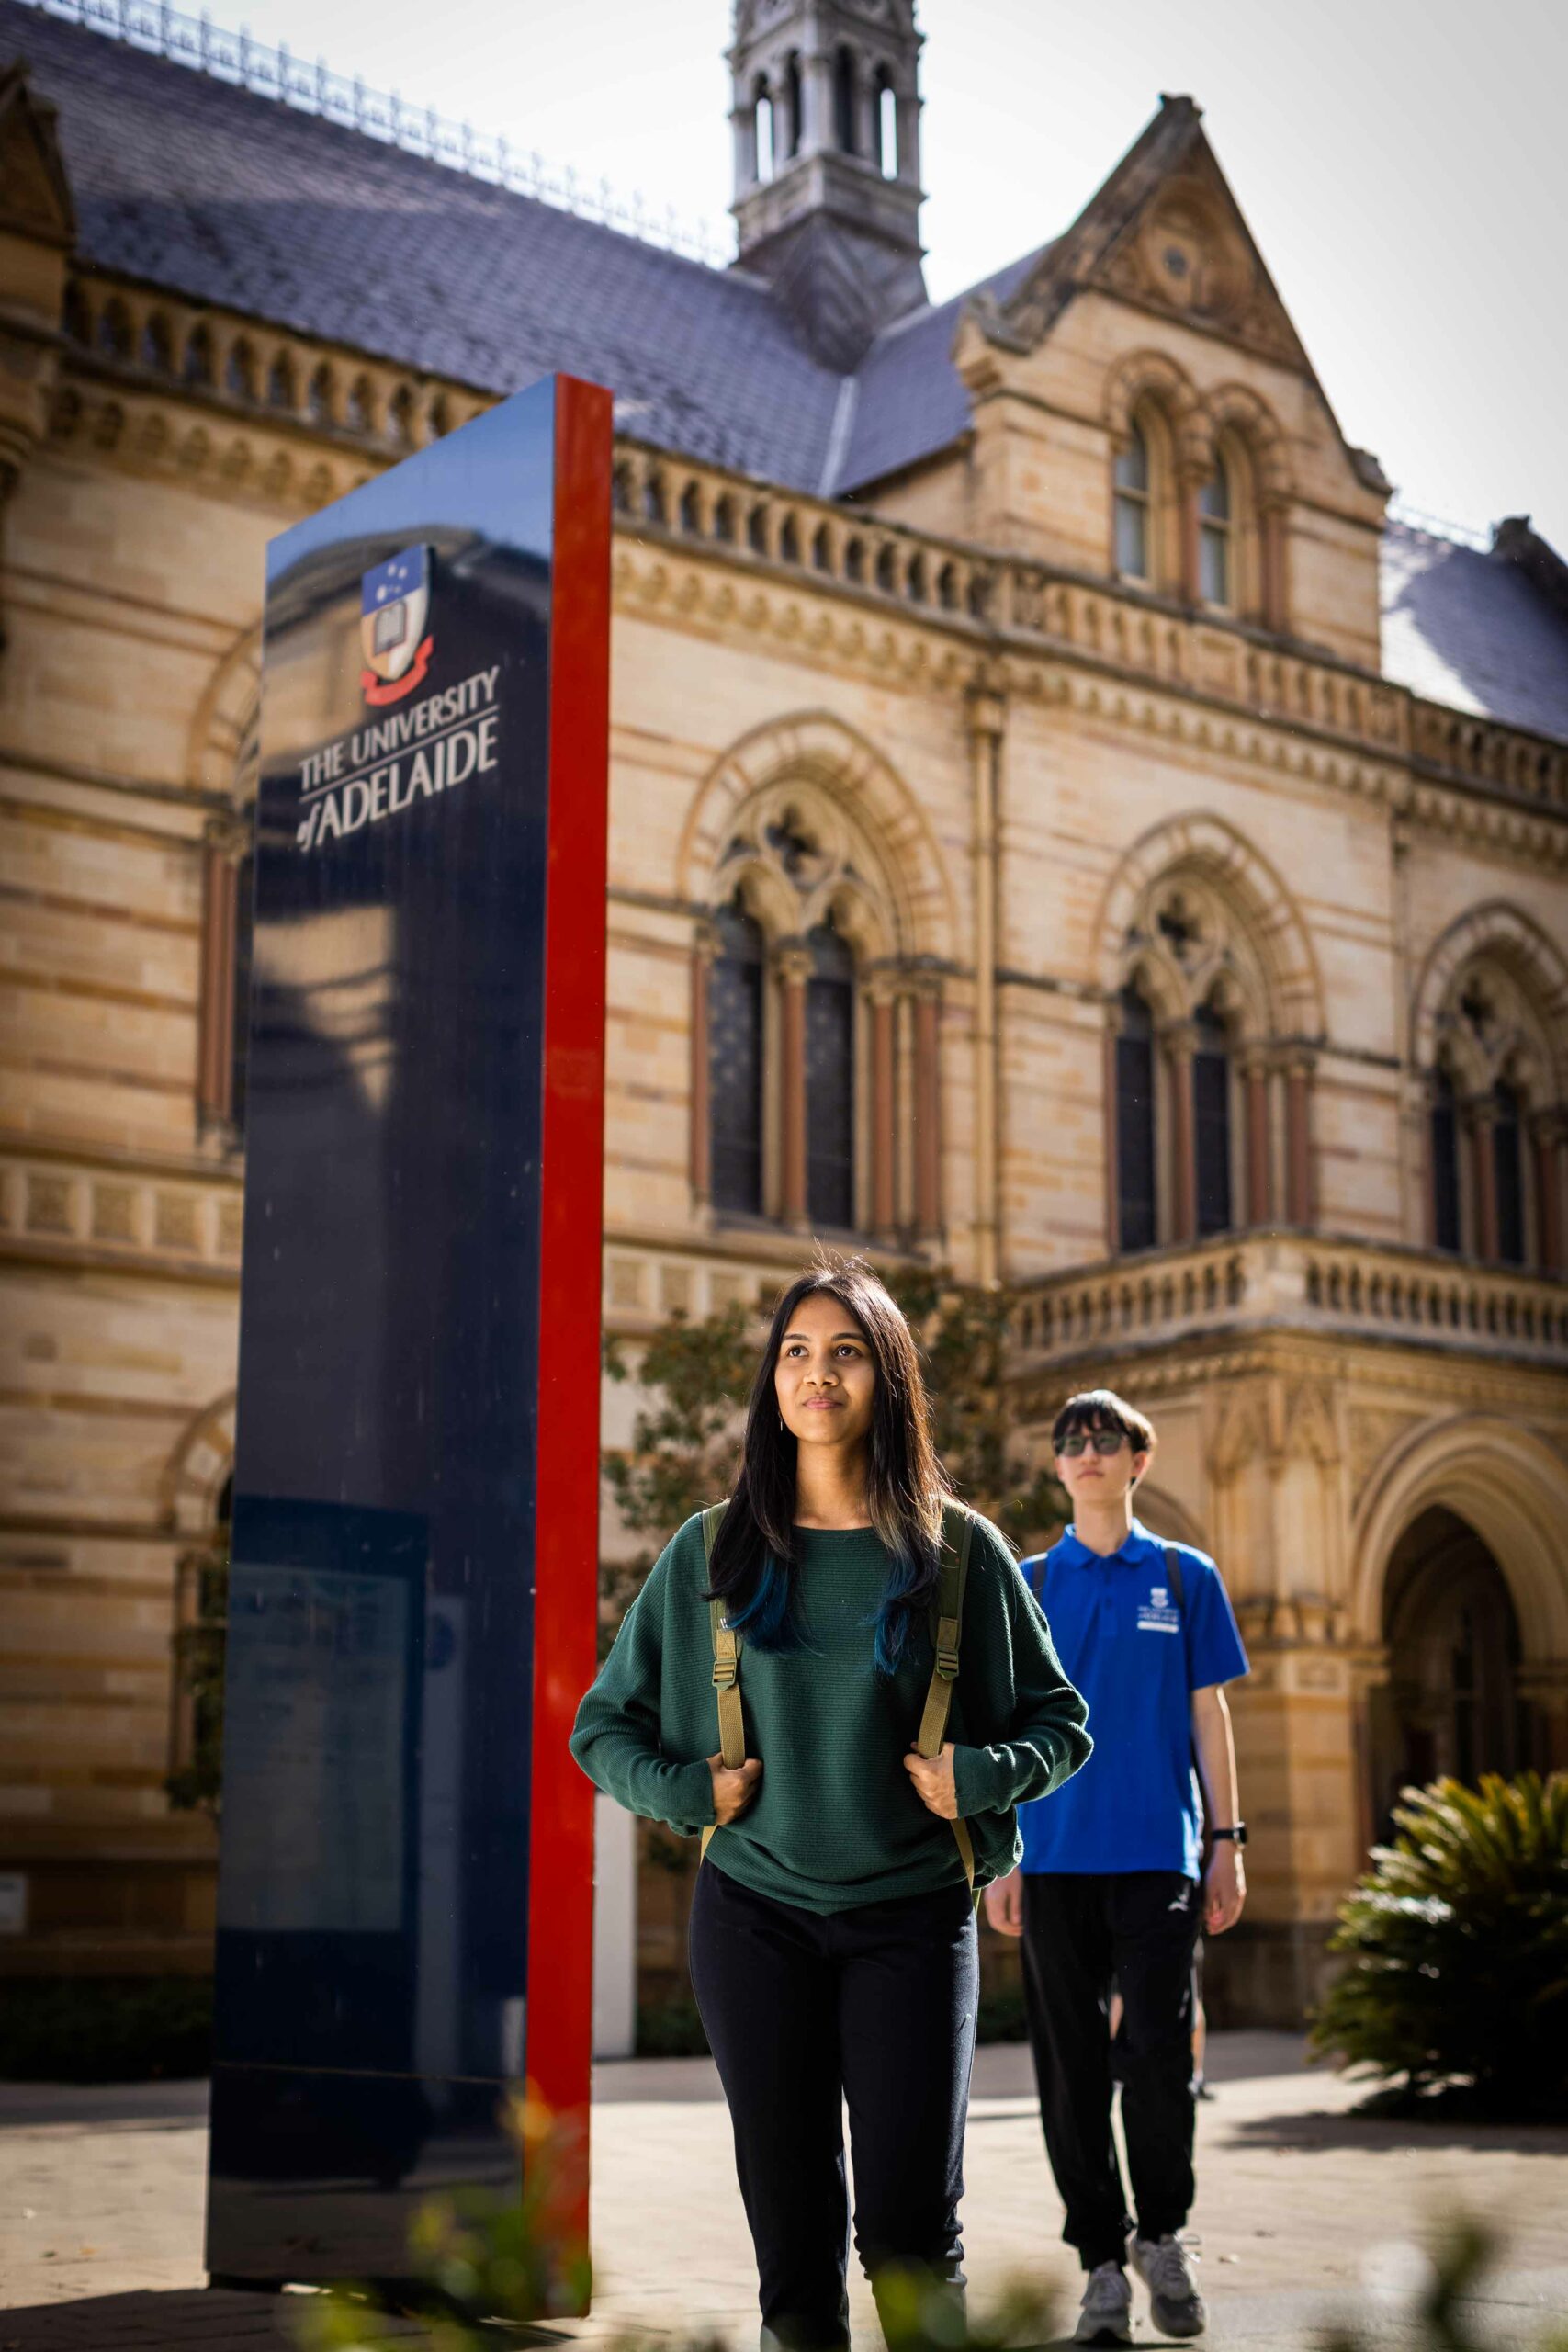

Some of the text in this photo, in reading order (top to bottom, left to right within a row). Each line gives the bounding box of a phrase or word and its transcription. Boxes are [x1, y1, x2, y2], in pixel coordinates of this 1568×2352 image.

[296, 716, 499, 853] of ADELAIDE
[299, 665, 500, 790] THE UNIVERSITY
